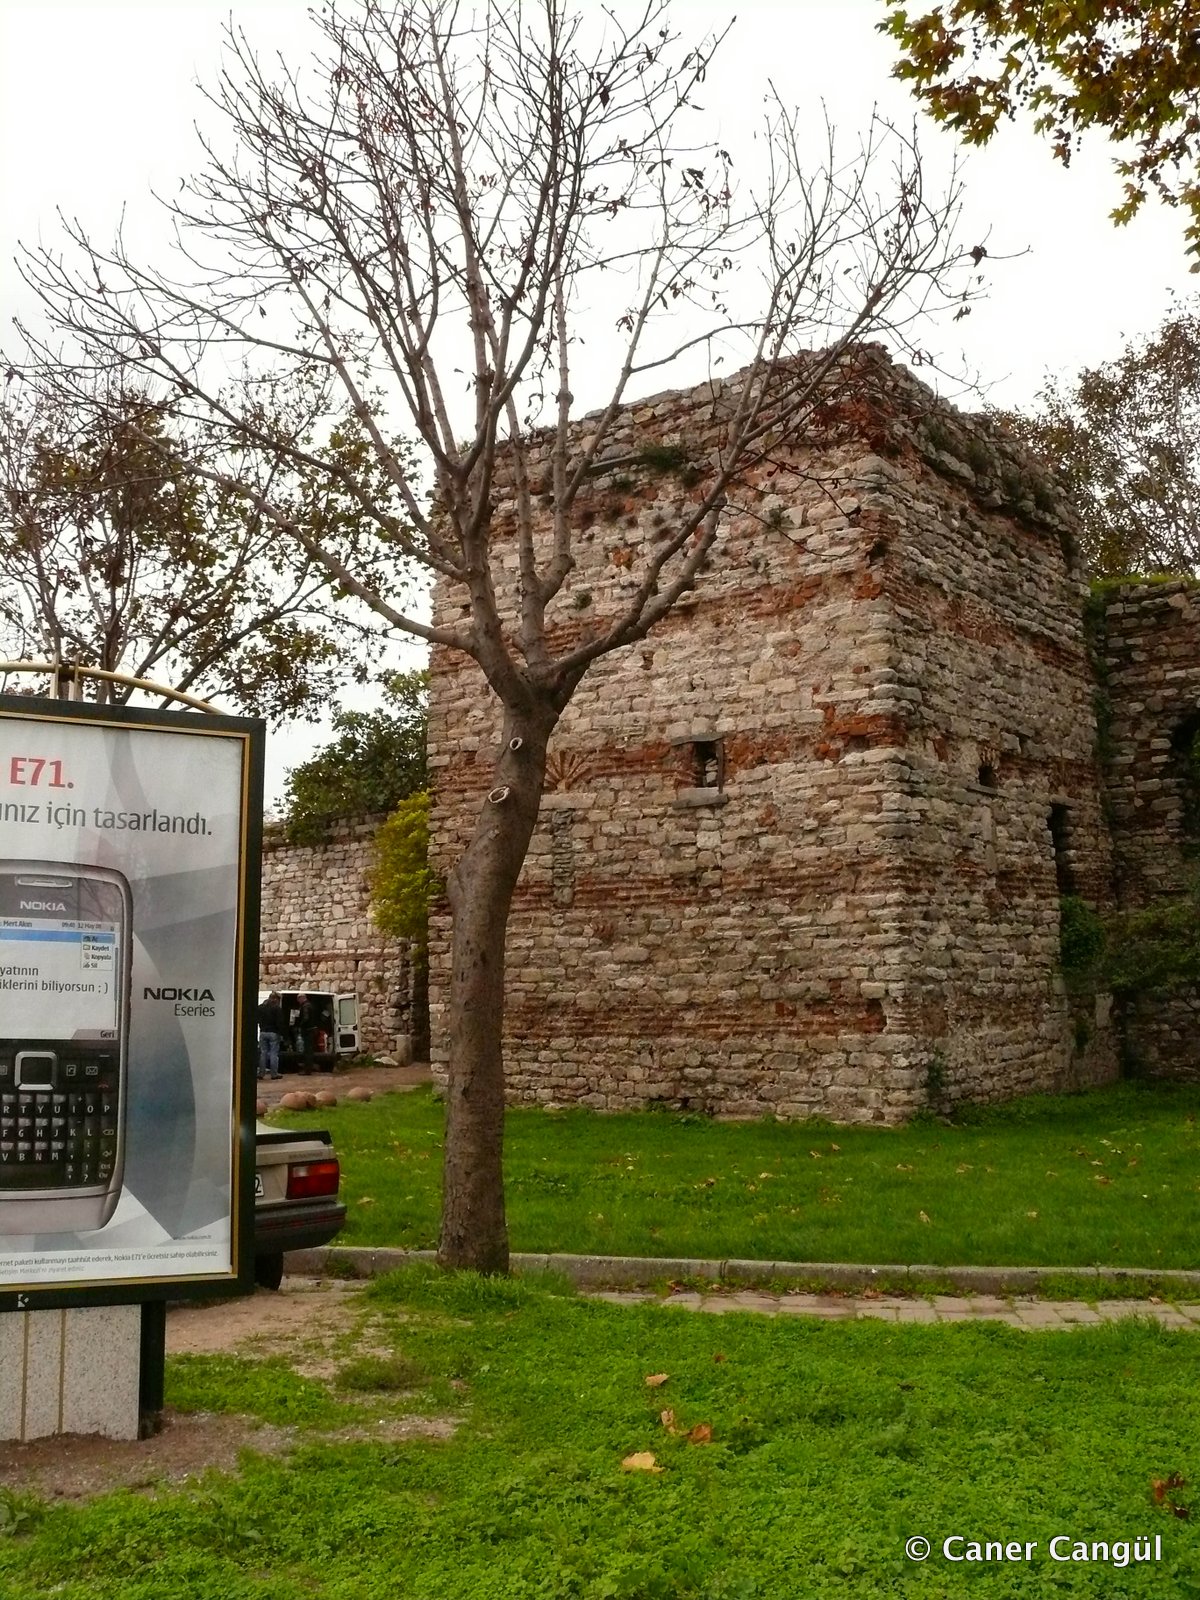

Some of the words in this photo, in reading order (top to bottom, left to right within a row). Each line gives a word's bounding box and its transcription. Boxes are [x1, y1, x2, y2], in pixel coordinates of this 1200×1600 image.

[10, 756, 74, 789] E71.
[46, 801, 86, 829] için
[93, 809, 213, 836] tasarlandı.
[20, 901, 67, 912] NOKIA
[41, 980, 95, 994] biliyorsun
[143, 987, 216, 1002] NOKIA
[174, 1003, 216, 1017] Eseries
[100, 1030, 115, 1038] Geri
[3, 1105, 10, 1114] R
[20, 1105, 27, 1114] T
[37, 1105, 45, 1114] Y
[54, 1105, 61, 1114] U
[104, 1105, 110, 1113] P
[2, 1129, 8, 1138] F
[18, 1129, 24, 1138] G
[36, 1129, 43, 1138] H
[53, 1129, 59, 1137] J
[69, 1128, 76, 1137] K
[87, 1128, 92, 1137] L
[2, 1152, 9, 1162] V
[19, 1152, 26, 1162] B
[35, 1152, 43, 1161] N
[51, 1152, 59, 1161] M
